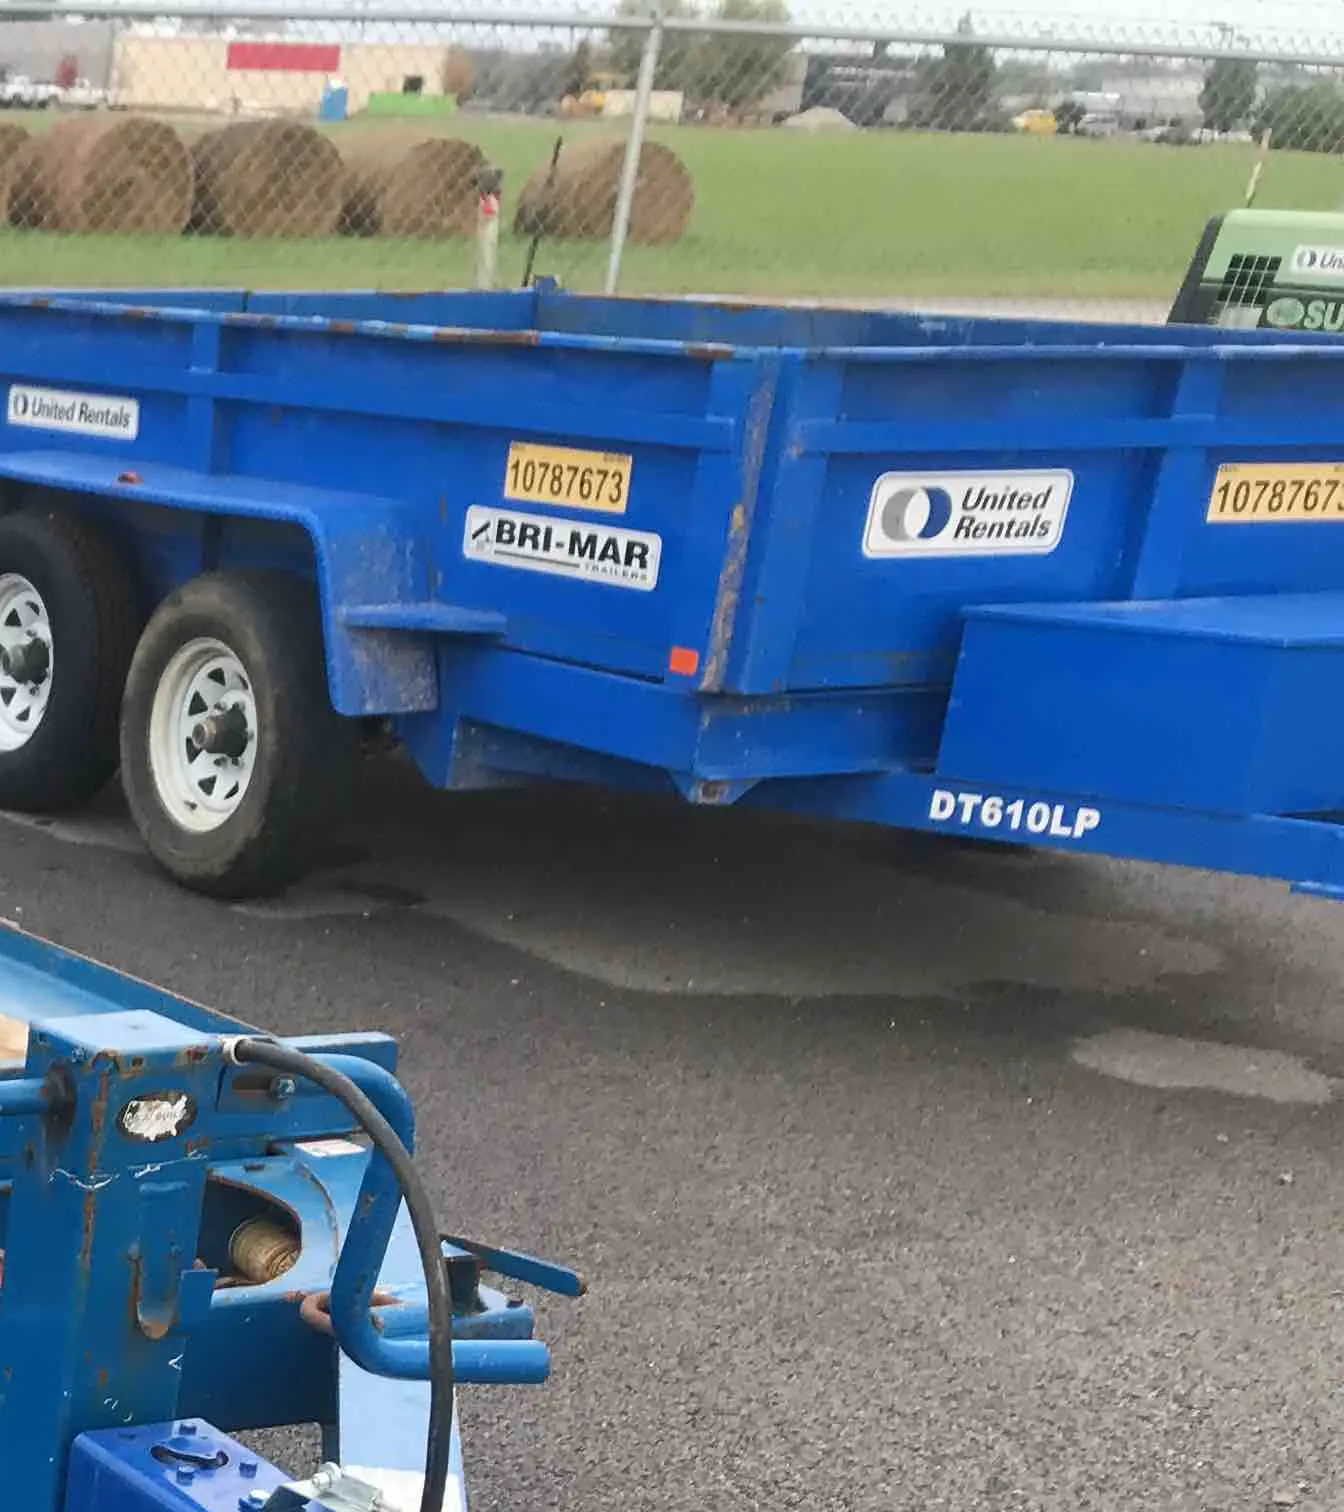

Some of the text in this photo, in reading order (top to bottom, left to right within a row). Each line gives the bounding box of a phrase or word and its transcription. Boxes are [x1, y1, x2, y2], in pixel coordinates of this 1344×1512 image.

[32, 396, 131, 428] United Rentals
[511, 458, 623, 504] 10787673
[961, 485, 1053, 512] United
[495, 517, 649, 569] BRI-MAR
[954, 513, 1052, 540] Rentals
[929, 788, 1101, 838] DT610LP
